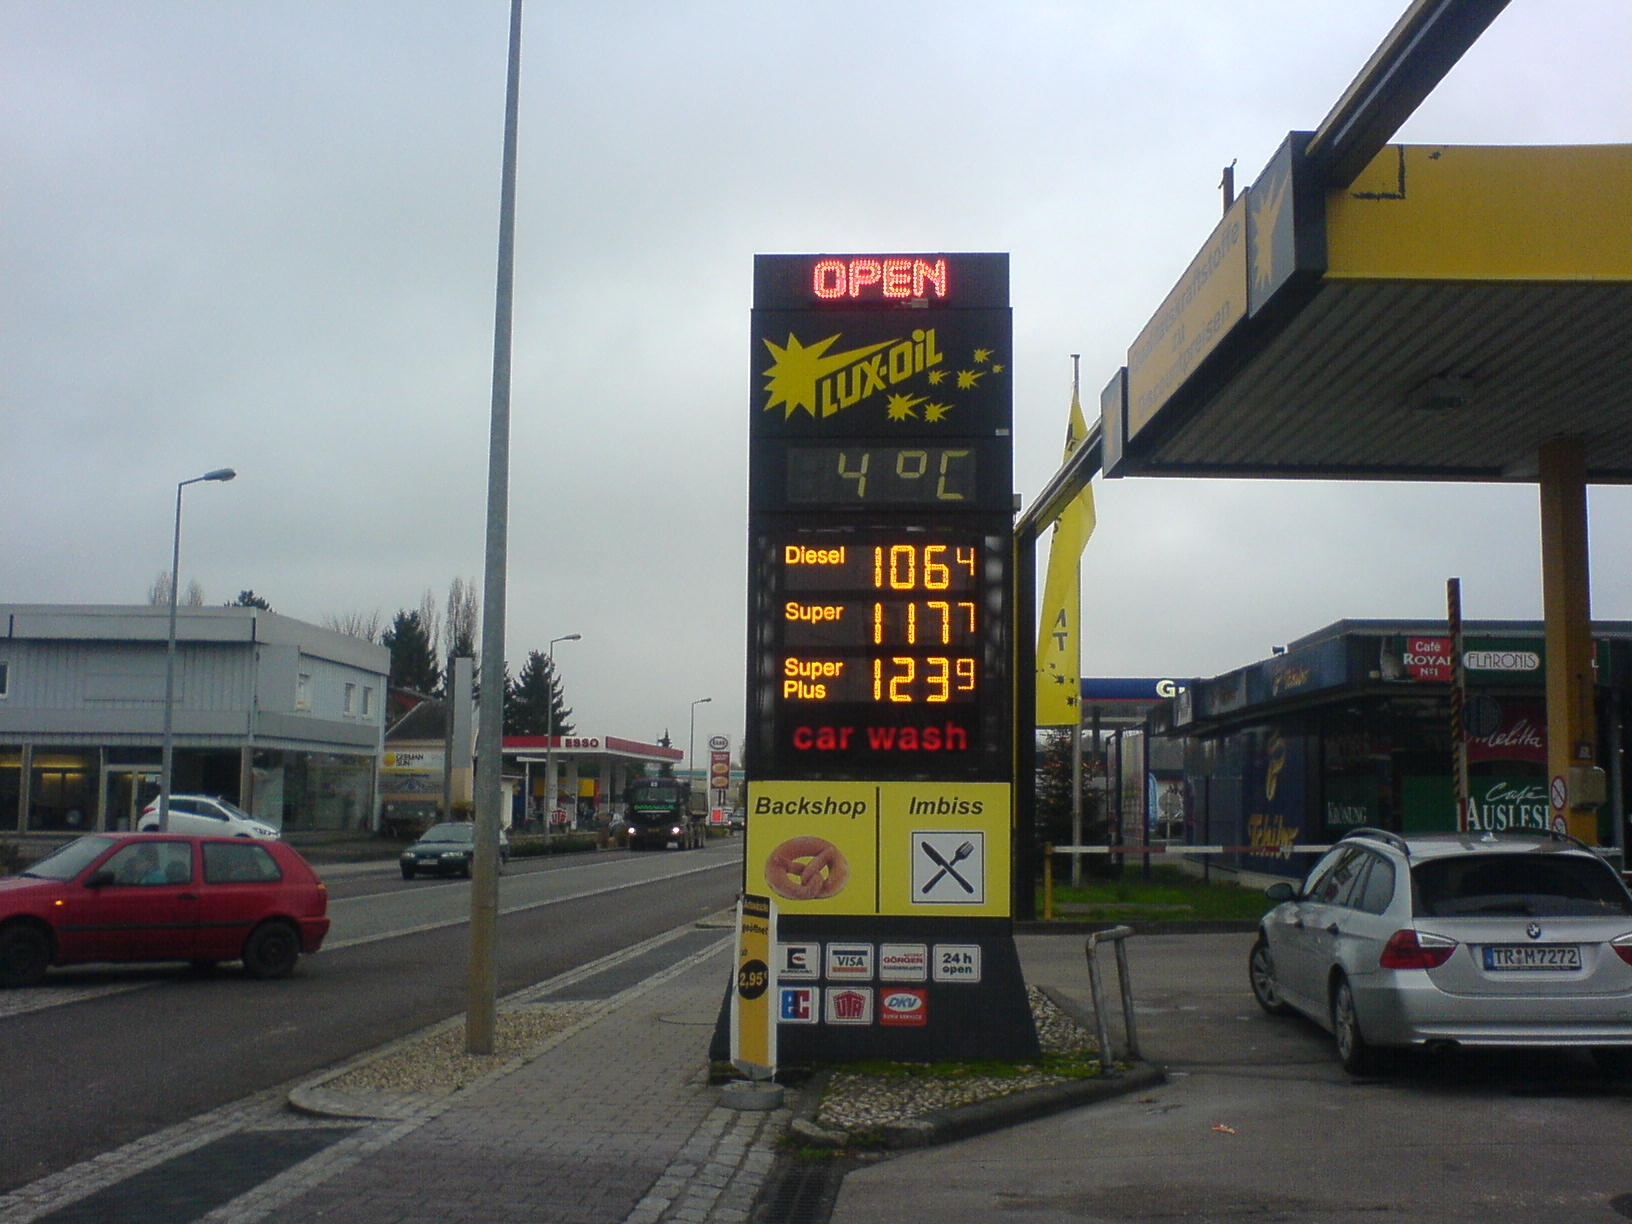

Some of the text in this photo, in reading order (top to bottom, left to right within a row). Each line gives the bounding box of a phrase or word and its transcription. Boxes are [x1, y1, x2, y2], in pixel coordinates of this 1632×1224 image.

[814, 259, 946, 298] OPEN
[838, 452, 869, 498] 4
[785, 545, 845, 564] Diesel
[785, 602, 844, 624] Super
[1415, 640, 1441, 652] Café
[784, 657, 844, 680] Super
[784, 681, 826, 699] Plus
[793, 721, 967, 750] car wash
[1466, 719, 1542, 748] elitta
[564, 738, 599, 749] ESSO
[754, 796, 984, 819] Backshop Imbiss
[837, 956, 864, 967] VISA
[942, 952, 972, 964] 24 h
[942, 966, 972, 975] open
[888, 997, 918, 1008] DKV
